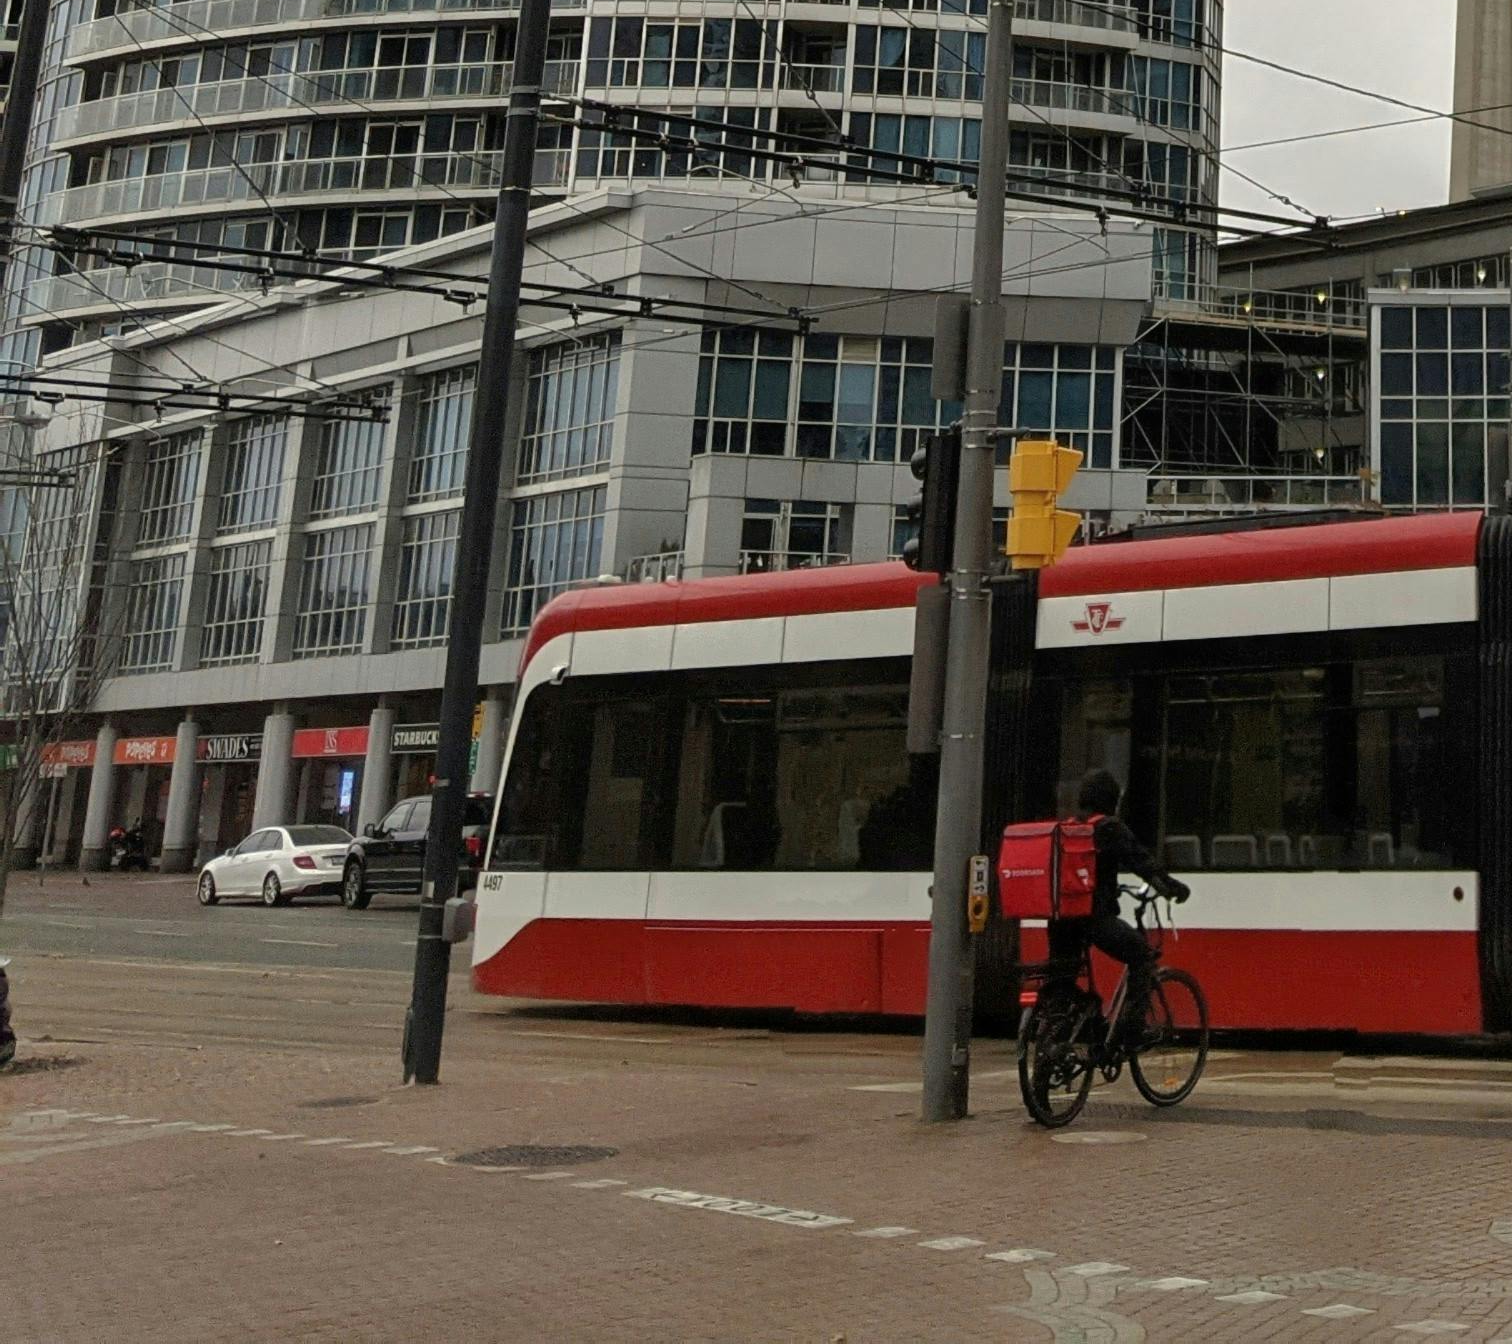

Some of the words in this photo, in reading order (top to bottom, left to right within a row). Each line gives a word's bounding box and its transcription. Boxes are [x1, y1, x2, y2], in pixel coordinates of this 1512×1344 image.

[393, 730, 440, 747] STARBUCK
[206, 736, 249, 760] SWADES
[483, 874, 503, 891] 4497
